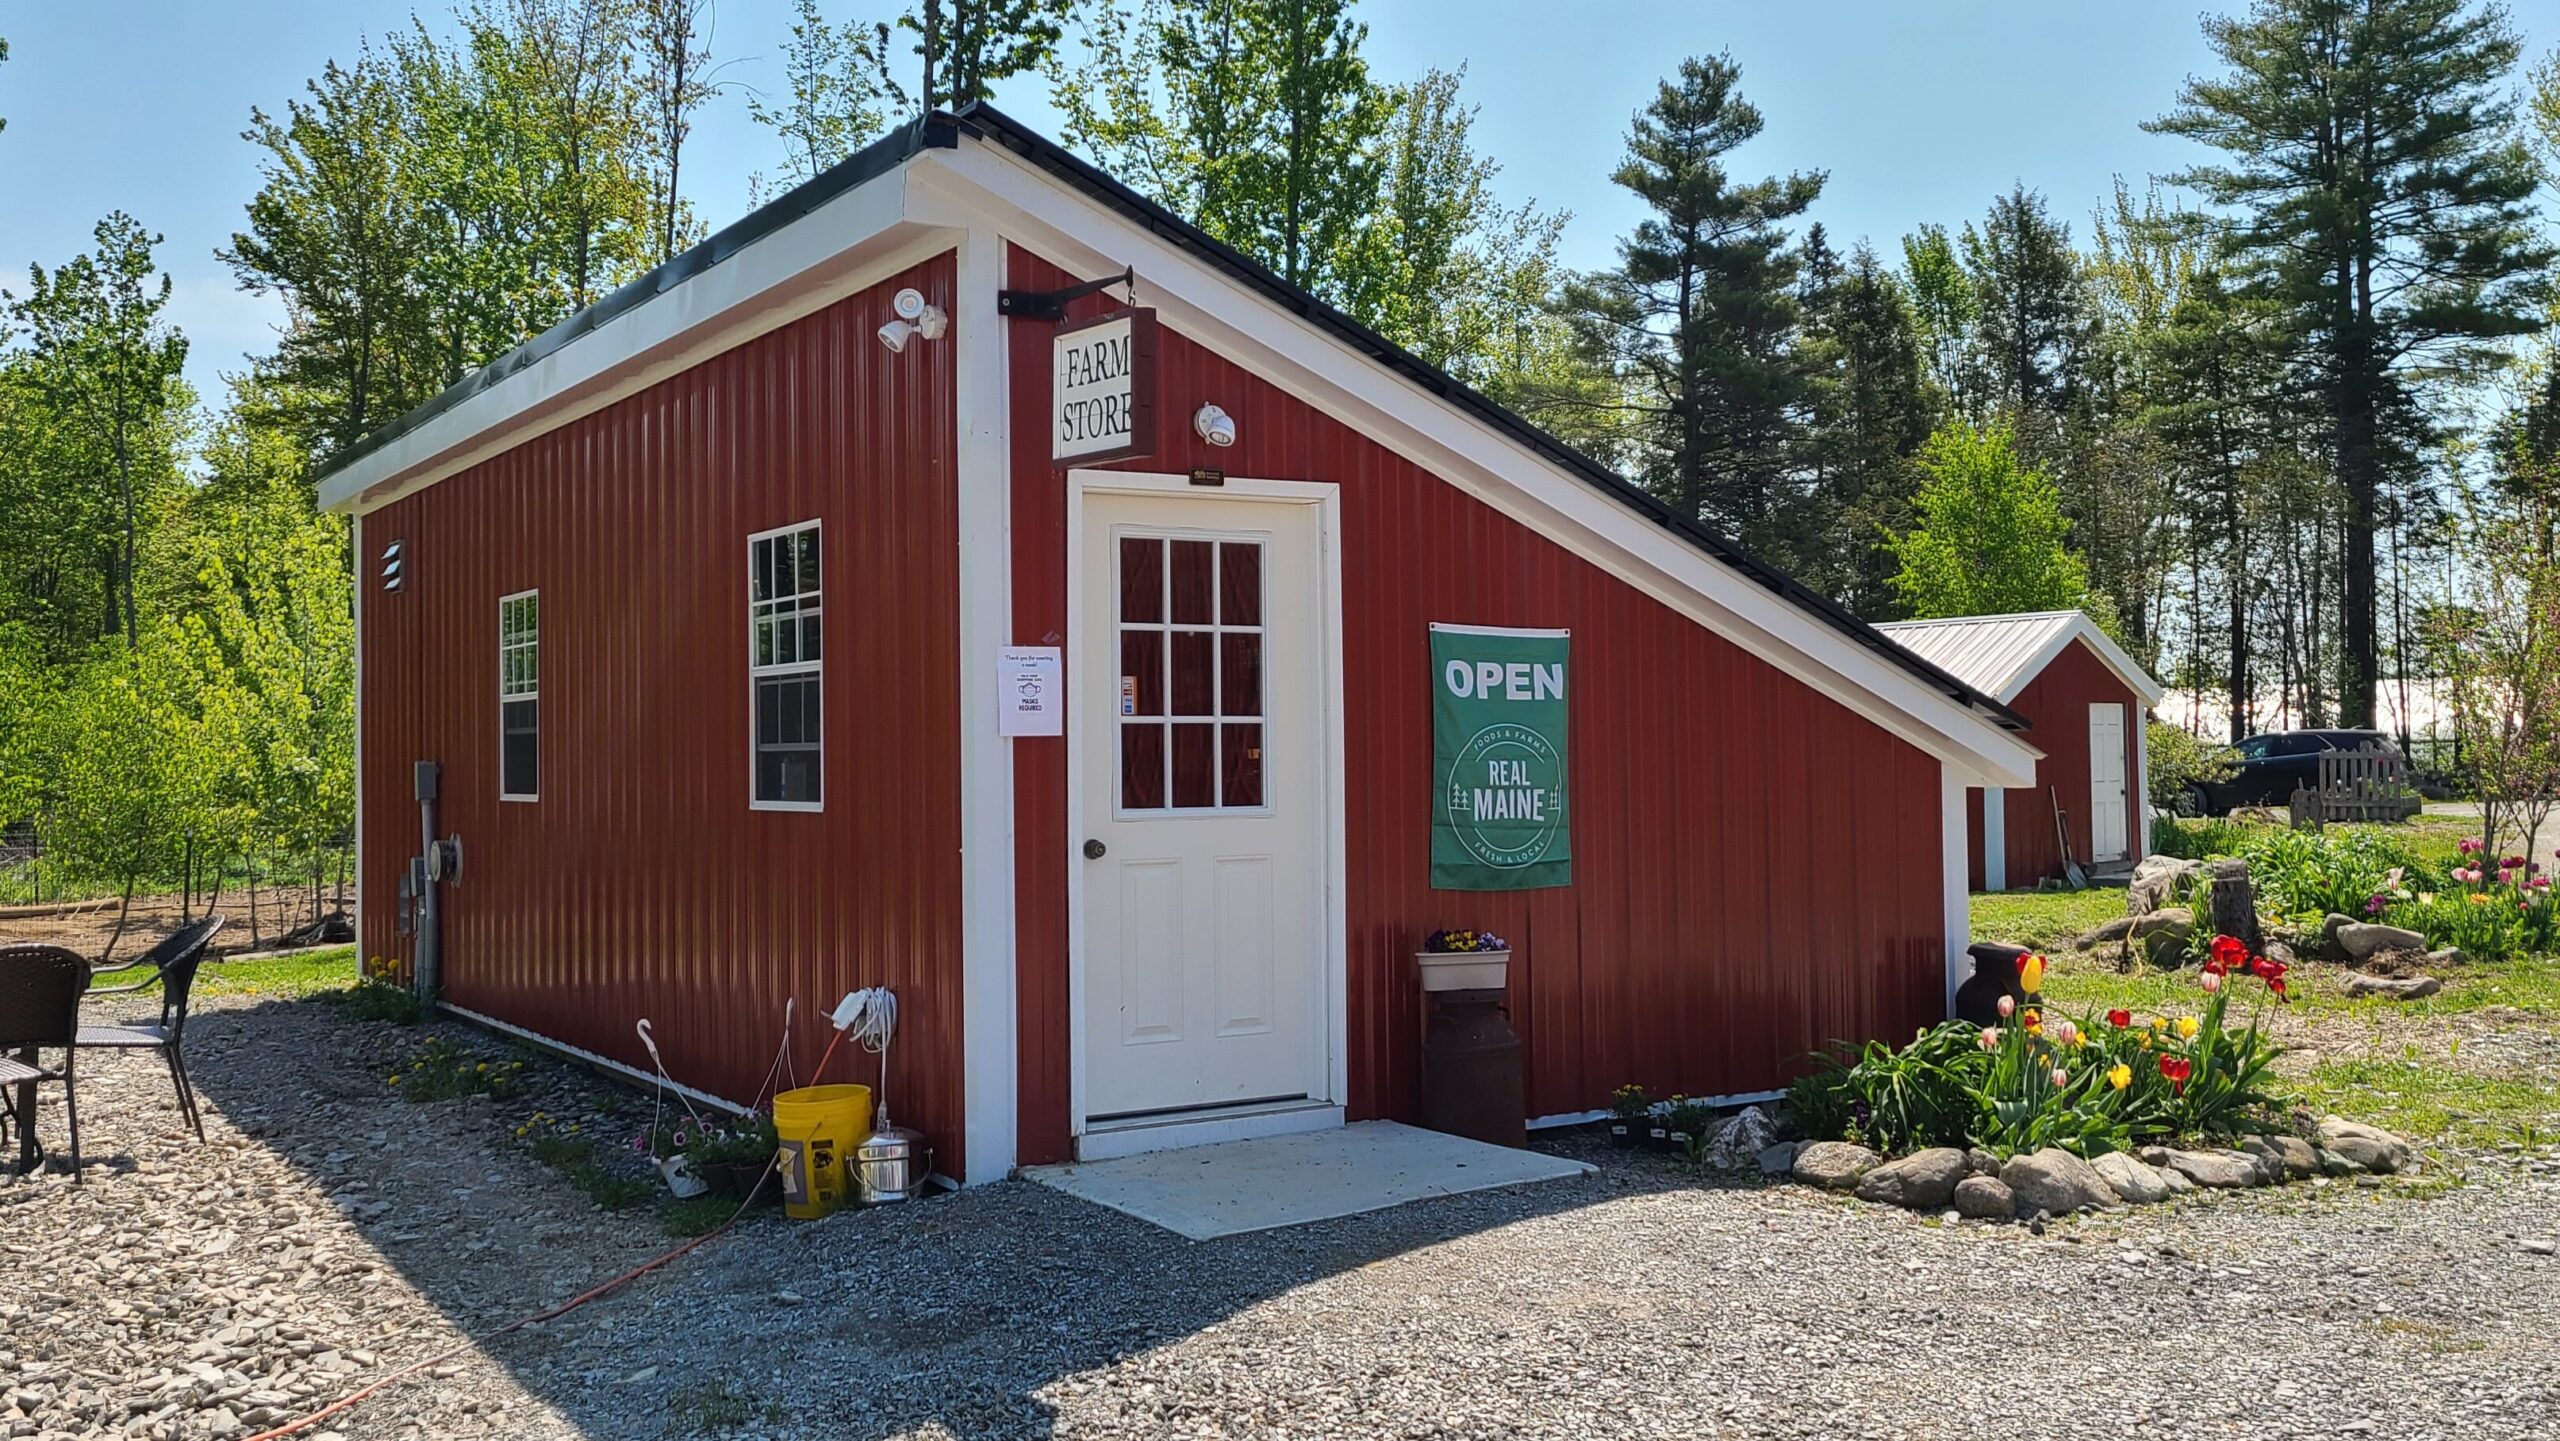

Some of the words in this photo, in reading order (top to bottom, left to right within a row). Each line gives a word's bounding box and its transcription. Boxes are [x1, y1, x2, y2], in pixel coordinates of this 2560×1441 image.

[1066, 335, 1130, 389] FARM
[1062, 392, 1132, 442] STORE
[1446, 660, 1563, 700] OPEN
[1515, 731, 1546, 753] FARMS
[1488, 760, 1531, 786] REAL
[1473, 788, 1545, 822] MAINE
[1474, 841, 1502, 862] FRESH
[1517, 841, 1545, 862] LOCAL
